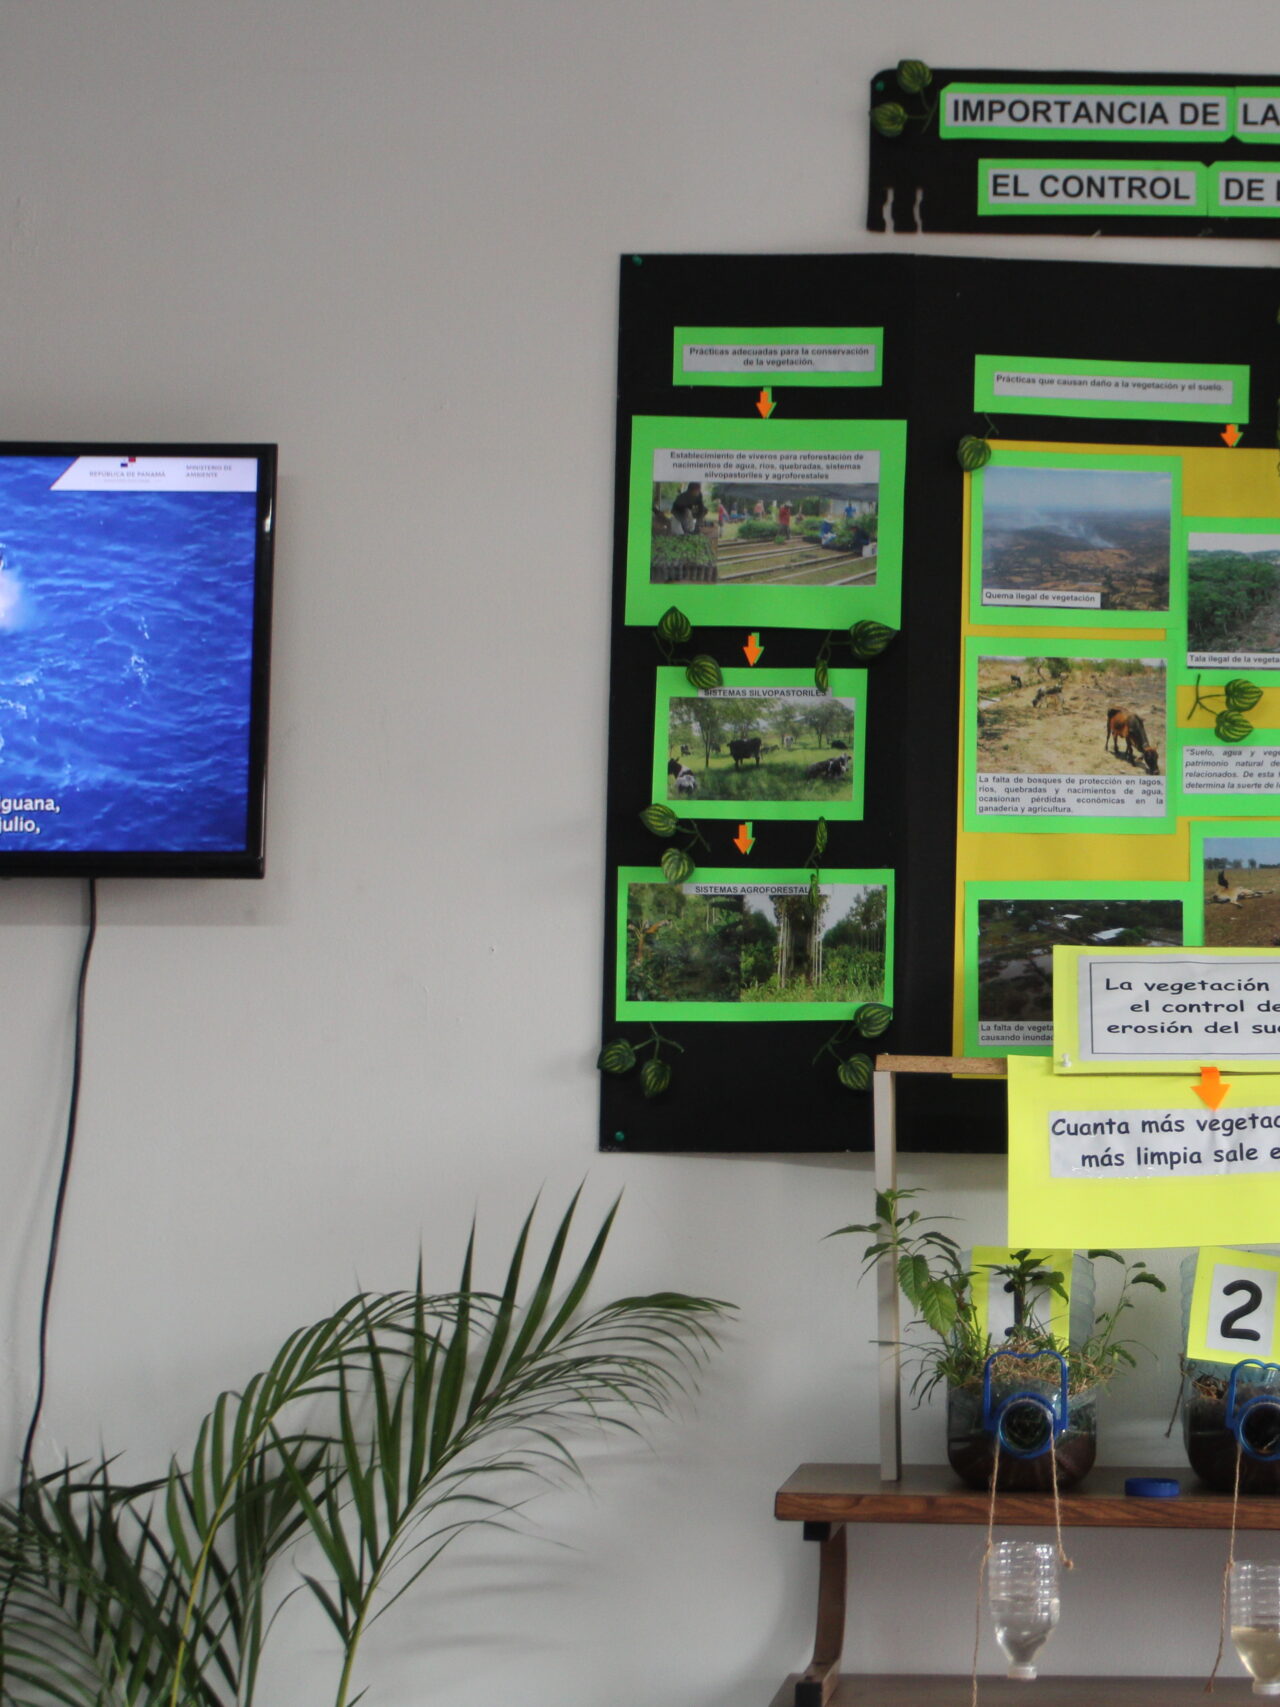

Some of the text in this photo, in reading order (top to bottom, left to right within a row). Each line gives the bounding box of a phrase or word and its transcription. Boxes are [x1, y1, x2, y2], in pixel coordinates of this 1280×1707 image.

[954, 99, 1169, 125] IMPORTANCIA
[1180, 102, 1220, 126] DE
[1242, 104, 1280, 126] LA
[992, 174, 1029, 198] EL
[1040, 175, 1190, 200] CONTROL
[1224, 178, 1265, 201] DE
[996, 374, 1036, 384] Prácticas
[1037, 378, 1055, 386] que
[1089, 379, 1112, 387] daño
[1120, 380, 1130, 388] la
[1130, 381, 1179, 391] vegetación
[1187, 382, 1196, 390] el
[985, 592, 1096, 603] Quema ilegal de vegetación
[1190, 655, 1206, 663] Tala
[1208, 655, 1230, 664] ilegal
[704, 689, 747, 697] SISTEMAS
[1242, 770, 1254, 778] De
[1003, 786, 1047, 794] quebradas
[1030, 796, 1066, 804] pérdidas
[741, 886, 820, 894] AGROFORESTALS
[1105, 978, 1132, 990] La
[1144, 979, 1269, 994] vegetación
[1129, 999, 1149, 1012] el
[1161, 1001, 1244, 1013] control
[1106, 1022, 1192, 1034] erosión
[1204, 1021, 1239, 1034] del
[1051, 1116, 1130, 1137] Cuanta
[1140, 1113, 1185, 1133] más
[1081, 1146, 1124, 1168] más
[1136, 1144, 1202, 1169] limpia
[1213, 1142, 1258, 1163] sale
[1221, 1279, 1263, 1342] 2
